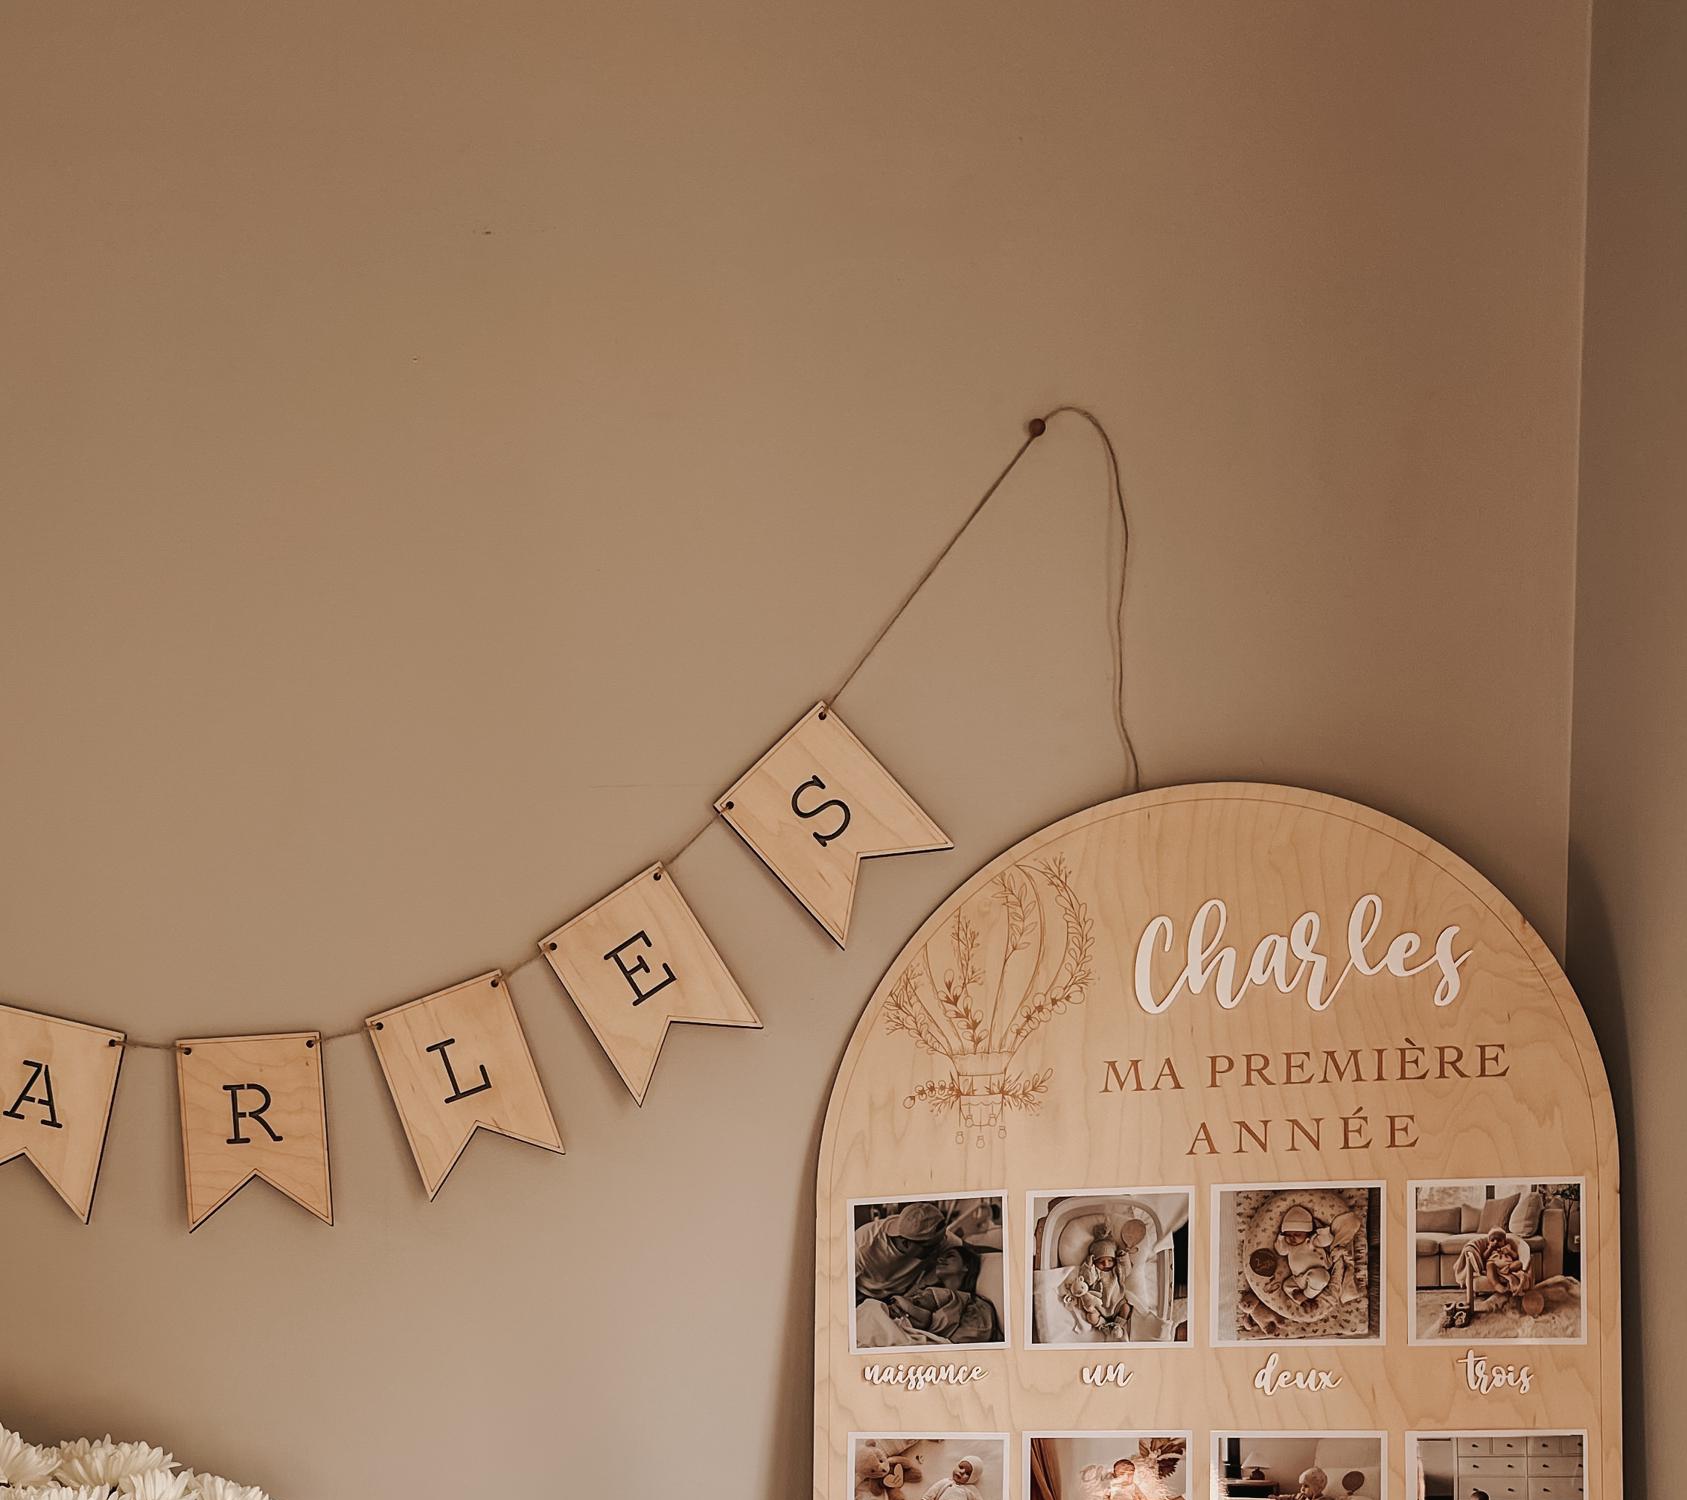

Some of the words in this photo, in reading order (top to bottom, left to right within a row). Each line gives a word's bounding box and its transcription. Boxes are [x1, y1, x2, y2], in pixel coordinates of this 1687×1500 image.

[1134, 894, 1475, 1015] Charles
[1098, 1057, 1185, 1094] MA
[1206, 1042, 1511, 1088] PREMIÈRE
[1186, 1112, 1421, 1157] ANNÉE
[863, 1361, 989, 1389] naissance
[1081, 1361, 1134, 1389] un
[1254, 1352, 1343, 1392] deux
[1458, 1348, 1534, 1395] trois
